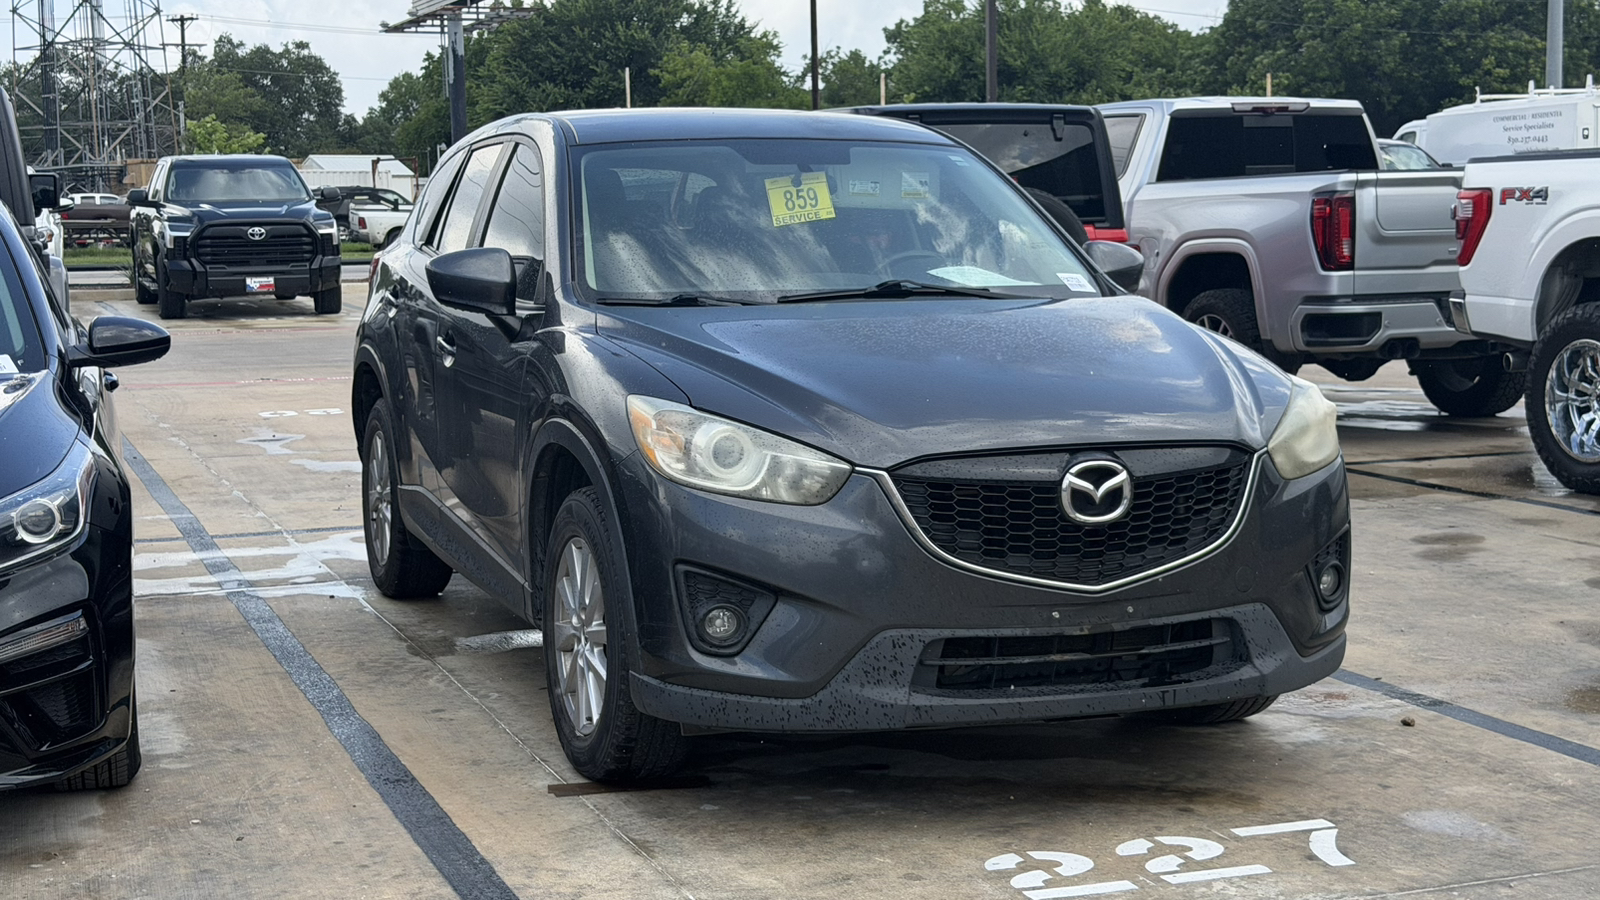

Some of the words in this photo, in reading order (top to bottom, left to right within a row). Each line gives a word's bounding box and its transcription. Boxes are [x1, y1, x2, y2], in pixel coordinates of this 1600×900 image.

[1493, 115, 1527, 123] COMMERCIAL
[1502, 125, 1523, 133] Service
[1523, 122, 1555, 132] Specialists
[1507, 135, 1548, 145] 830.237.0443
[783, 187, 819, 212] 859
[1499, 186, 1549, 205] FX4
[774, 211, 821, 226] SERVICE
[984, 818, 1356, 900] 227
